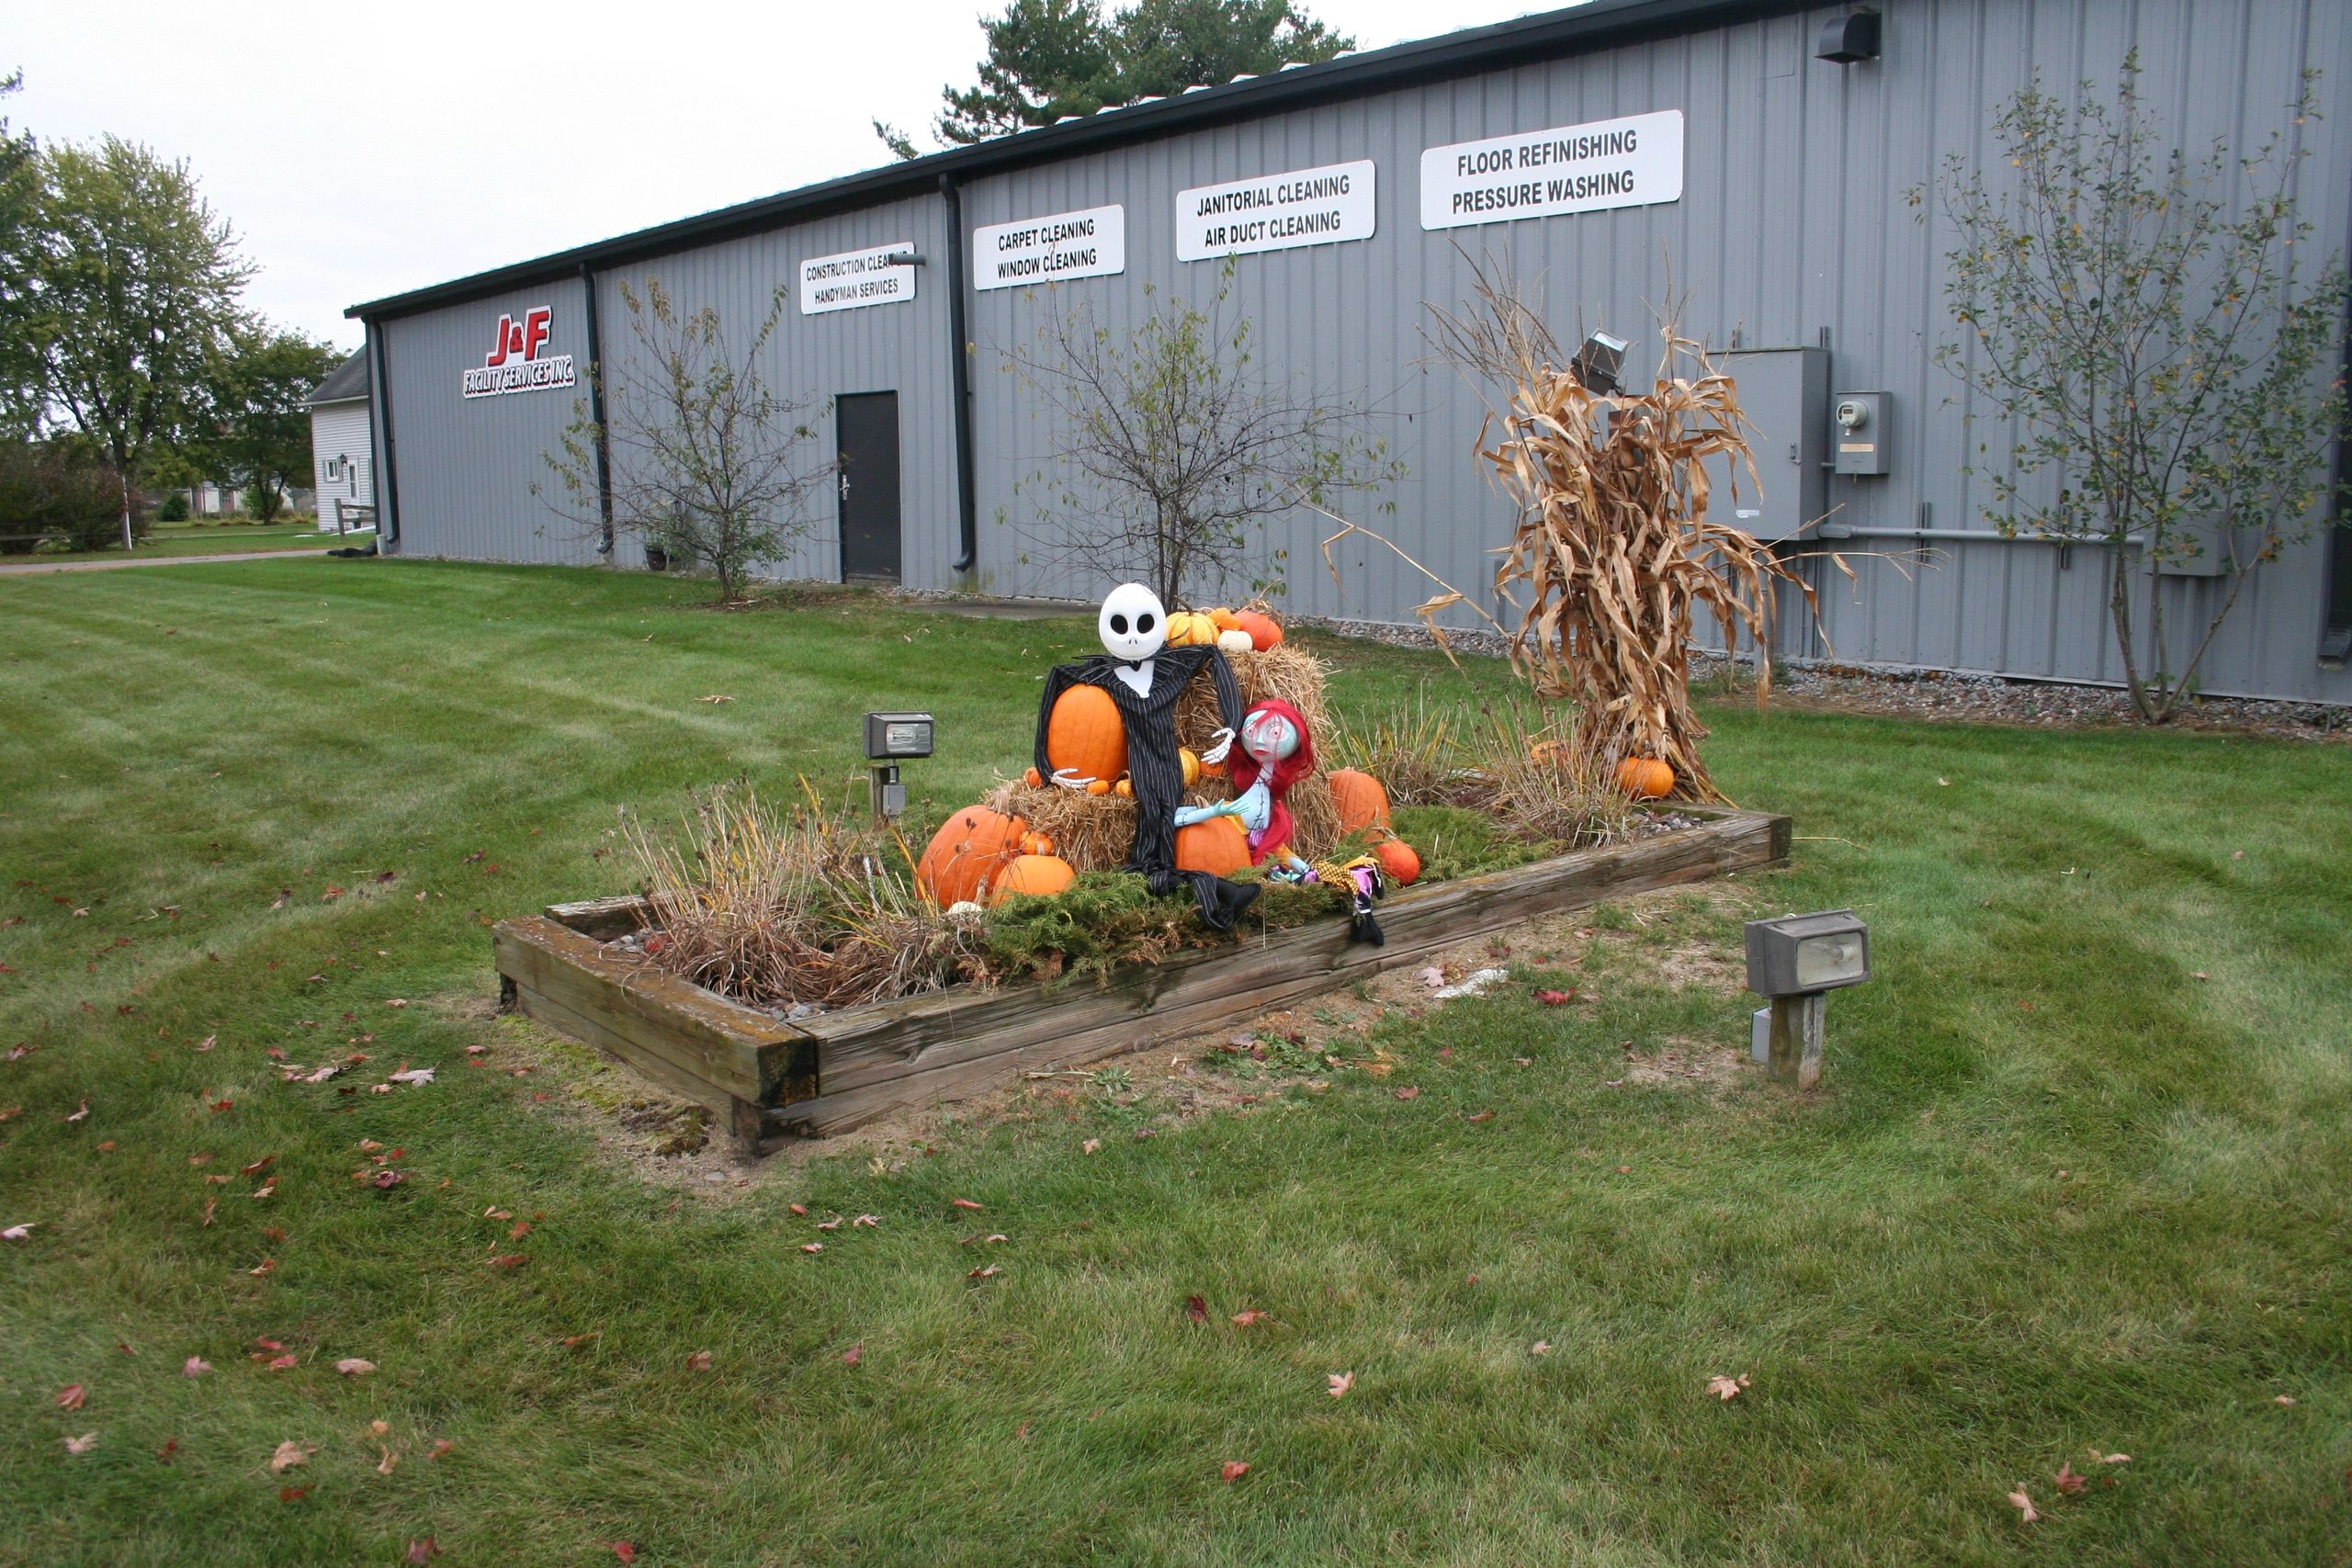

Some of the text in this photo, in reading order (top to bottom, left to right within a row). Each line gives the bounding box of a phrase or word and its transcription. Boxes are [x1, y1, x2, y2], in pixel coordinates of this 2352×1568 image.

[1458, 130, 1637, 176] FLOOR REFINISHING
[1197, 175, 1350, 217] JANITORIAL CLEANING
[1453, 170, 1634, 214] PRESSURE WASHING
[999, 219, 1094, 251] CARPET CLEANING
[1204, 210, 1340, 247] AIR DUCT CLEANING
[806, 258, 865, 281] CONSTRUCTION
[998, 248, 1097, 278] WINDOW CLEANING
[815, 278, 899, 305] HANDYMAN SERVICES
[464, 358, 573, 393] FACILITY SERVICES INC.
